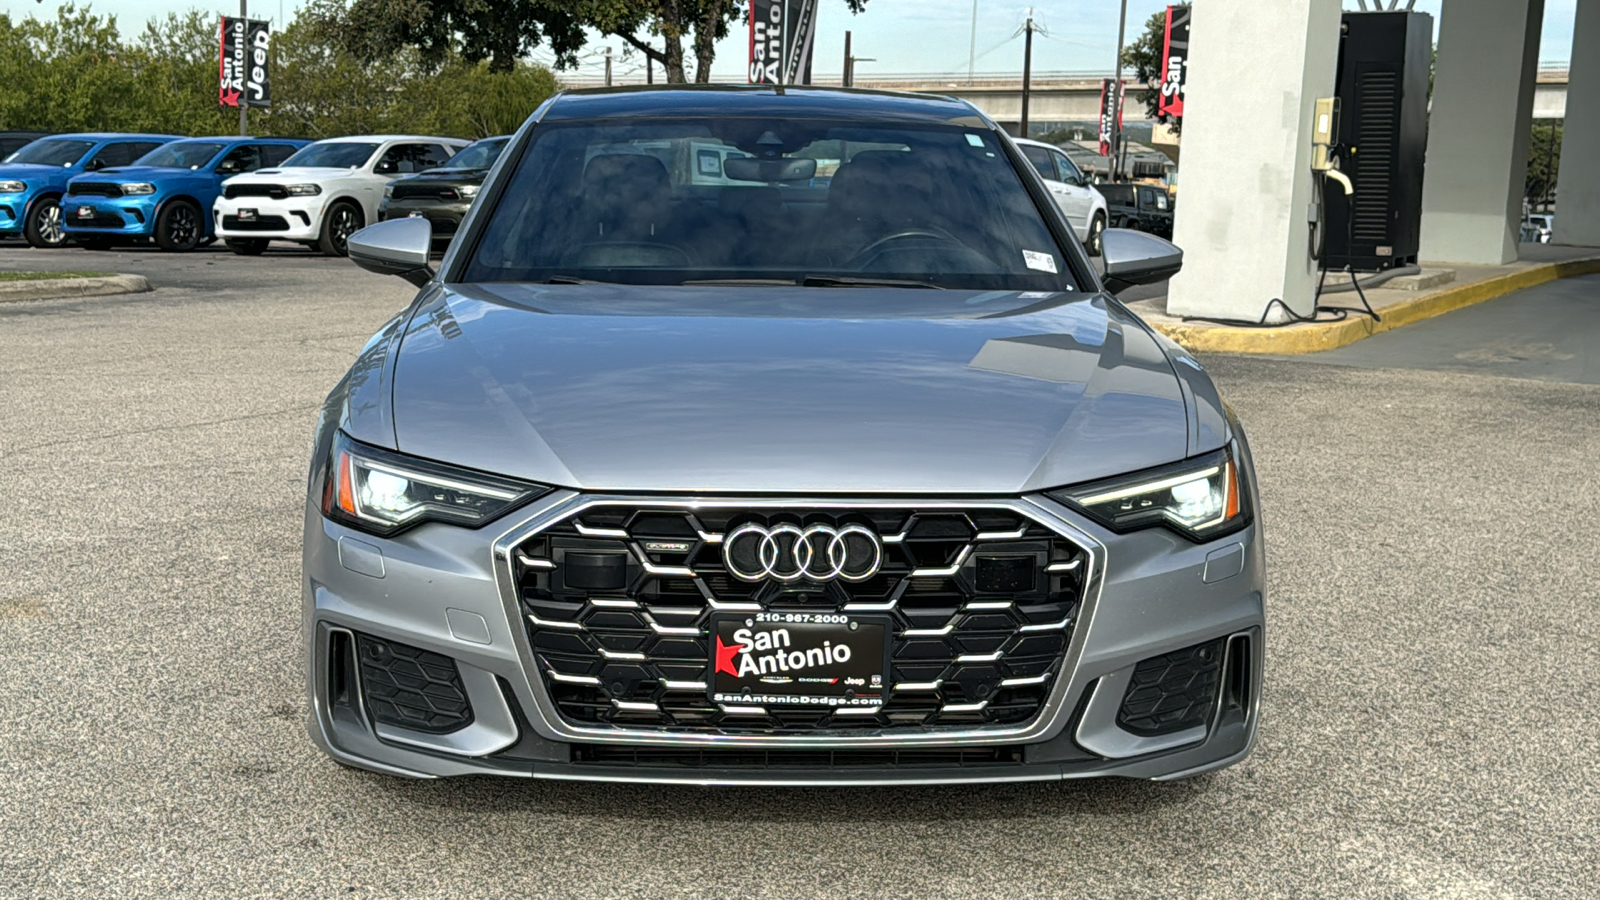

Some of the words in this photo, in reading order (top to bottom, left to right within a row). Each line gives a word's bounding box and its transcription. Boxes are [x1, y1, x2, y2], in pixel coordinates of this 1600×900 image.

[232, 22, 243, 91] Antonio
[750, 21, 765, 83] San
[765, 0, 781, 85] Anto
[221, 57, 232, 89] San
[247, 30, 269, 100] Jeep
[1161, 56, 1182, 96] San
[1104, 83, 1116, 143] Antonio
[756, 613, 848, 623] 210-967-2000
[733, 628, 791, 653] San
[738, 640, 851, 678] Antonio
[713, 693, 883, 706] SanAntonioDodge.com
[844, 677, 865, 686] Jeep
